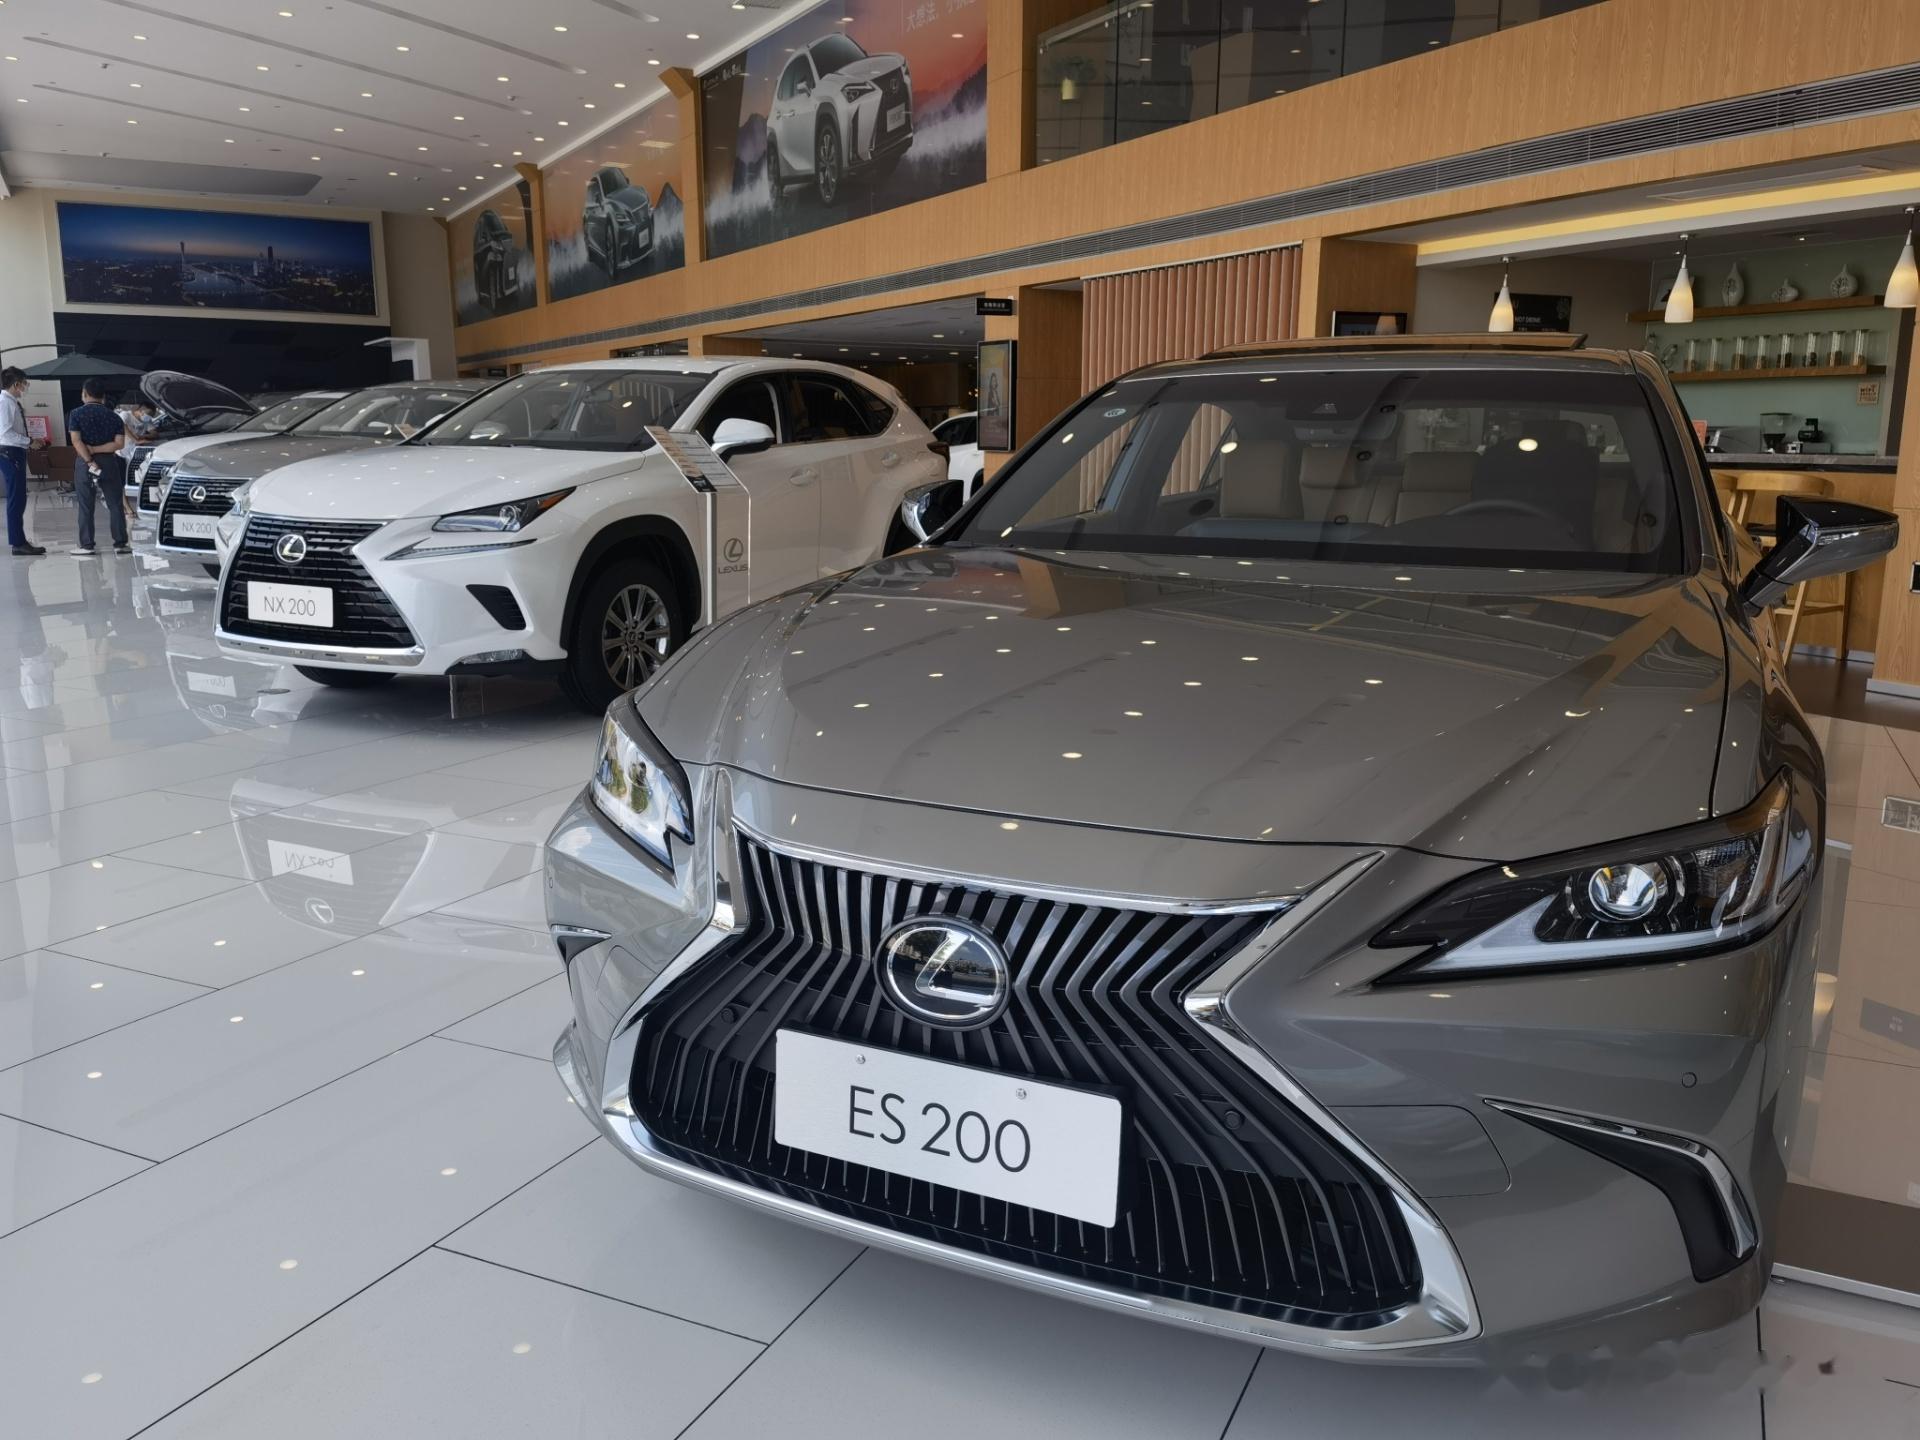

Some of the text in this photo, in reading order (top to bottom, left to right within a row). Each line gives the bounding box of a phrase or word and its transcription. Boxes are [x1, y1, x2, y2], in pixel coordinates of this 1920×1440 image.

[182, 522, 211, 534] NX 200
[718, 564, 748, 574] LEXUS
[264, 596, 316, 616] NX 200
[849, 1084, 1031, 1173] ES 200
